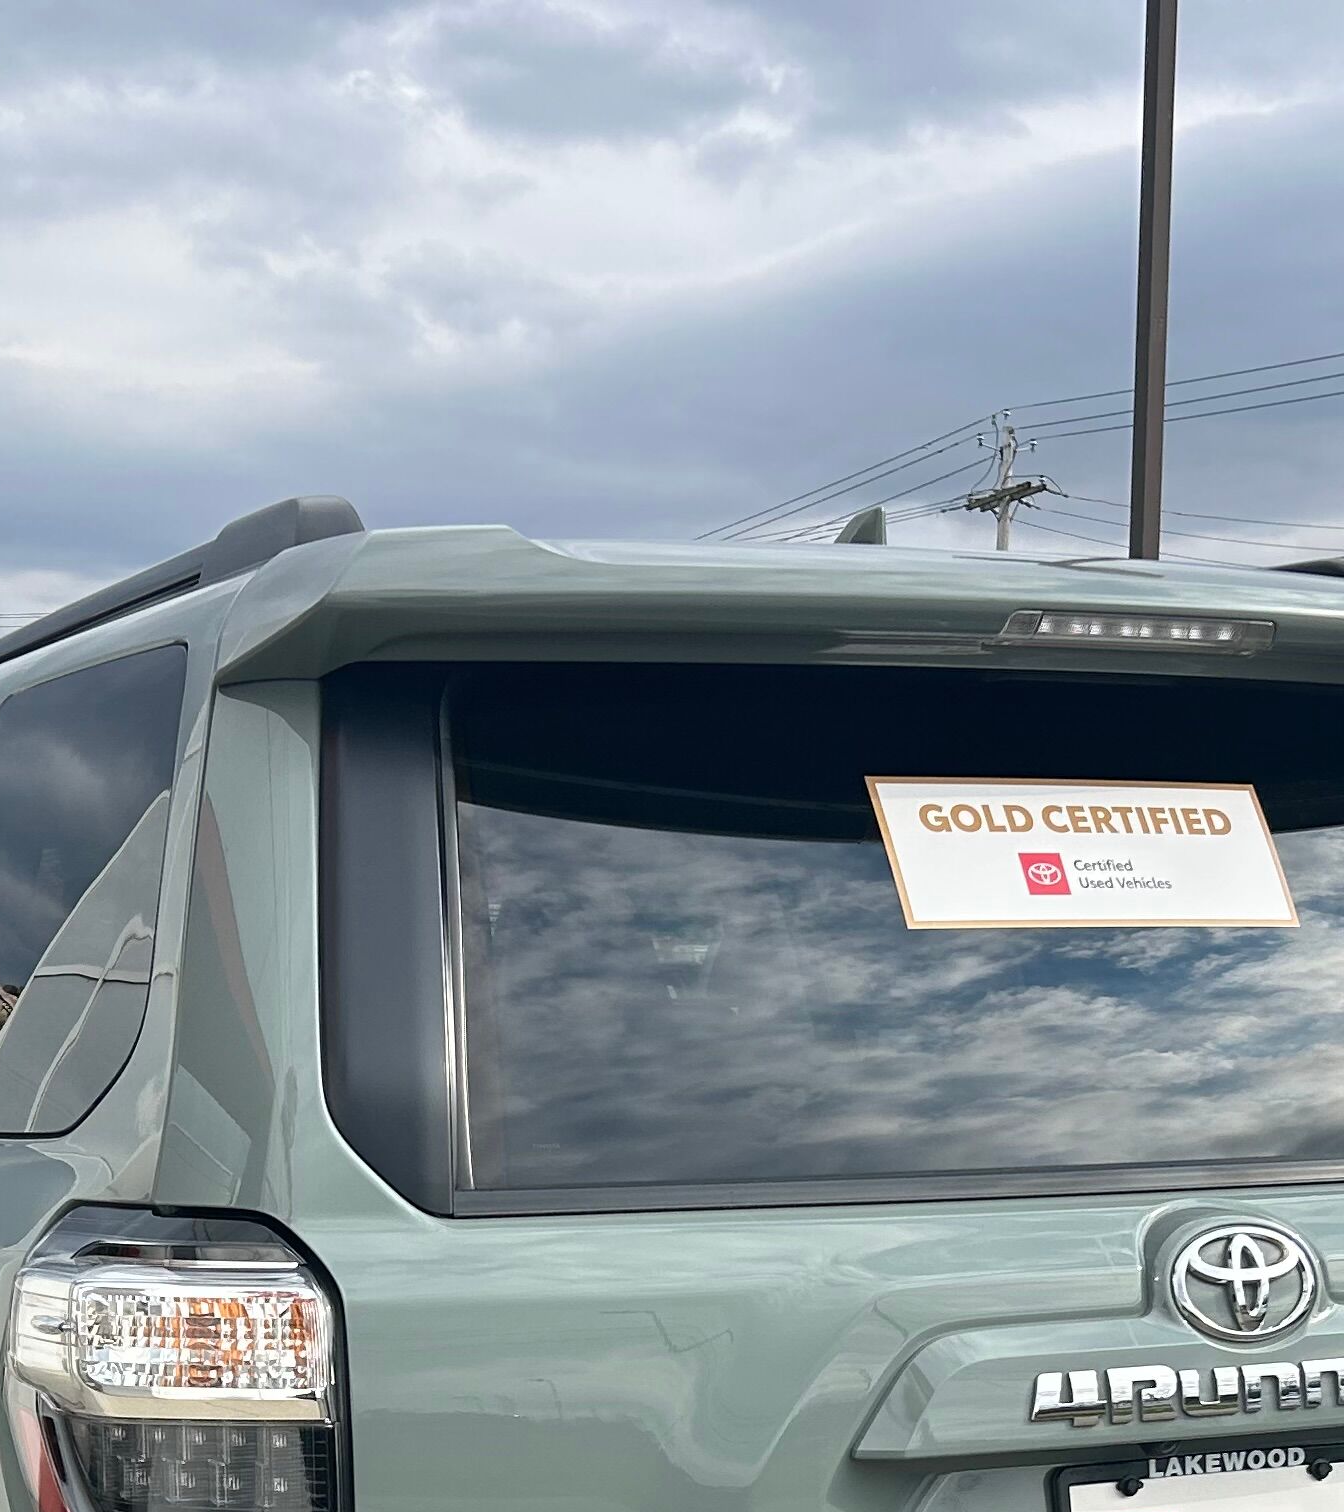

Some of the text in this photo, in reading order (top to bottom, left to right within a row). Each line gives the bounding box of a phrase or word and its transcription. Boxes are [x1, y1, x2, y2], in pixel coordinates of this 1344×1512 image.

[918, 803, 1233, 836] GOLD CERTIFIED
[1073, 858, 1134, 873] Certified
[1079, 876, 1173, 891] Used Vehicles
[1147, 1446, 1307, 1480] LAKEWOOD
